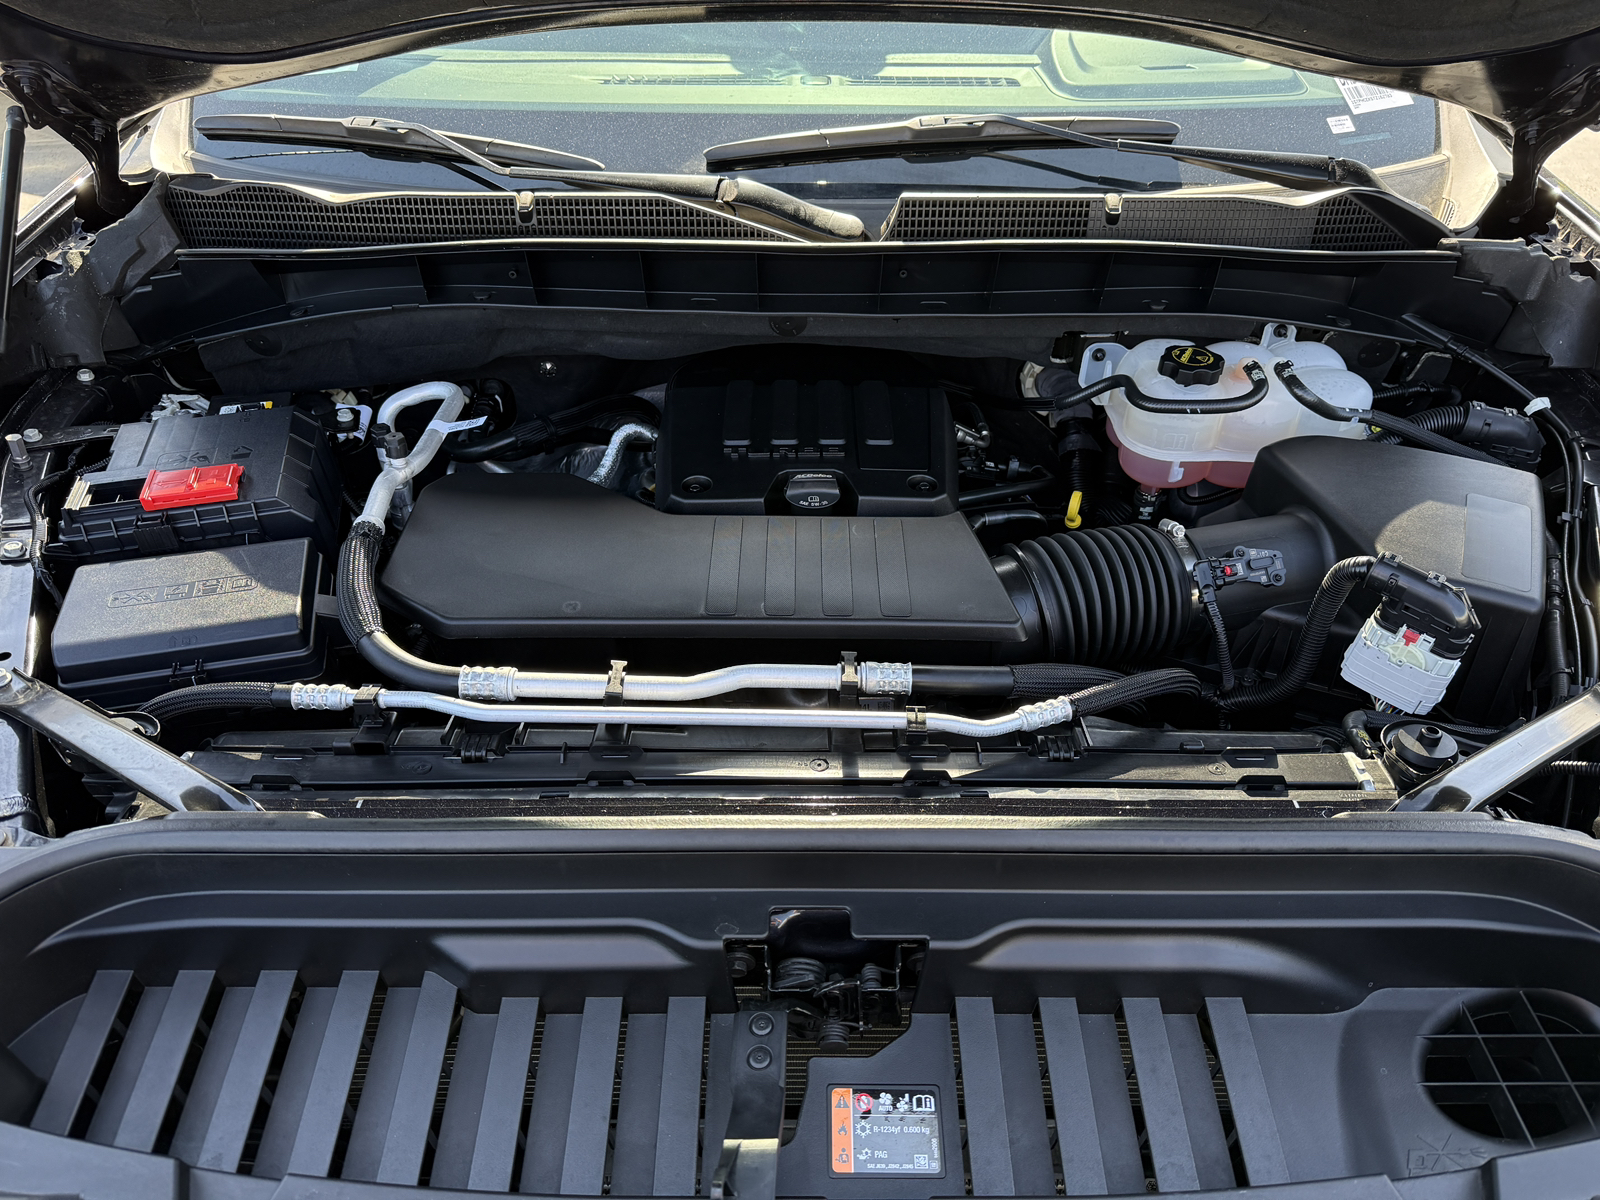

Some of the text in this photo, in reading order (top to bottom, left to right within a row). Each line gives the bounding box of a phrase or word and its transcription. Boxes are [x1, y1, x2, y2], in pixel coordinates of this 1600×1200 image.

[873, 1125, 930, 1134] R-1234yf 0.600 kg
[874, 1150, 888, 1158] PAG
